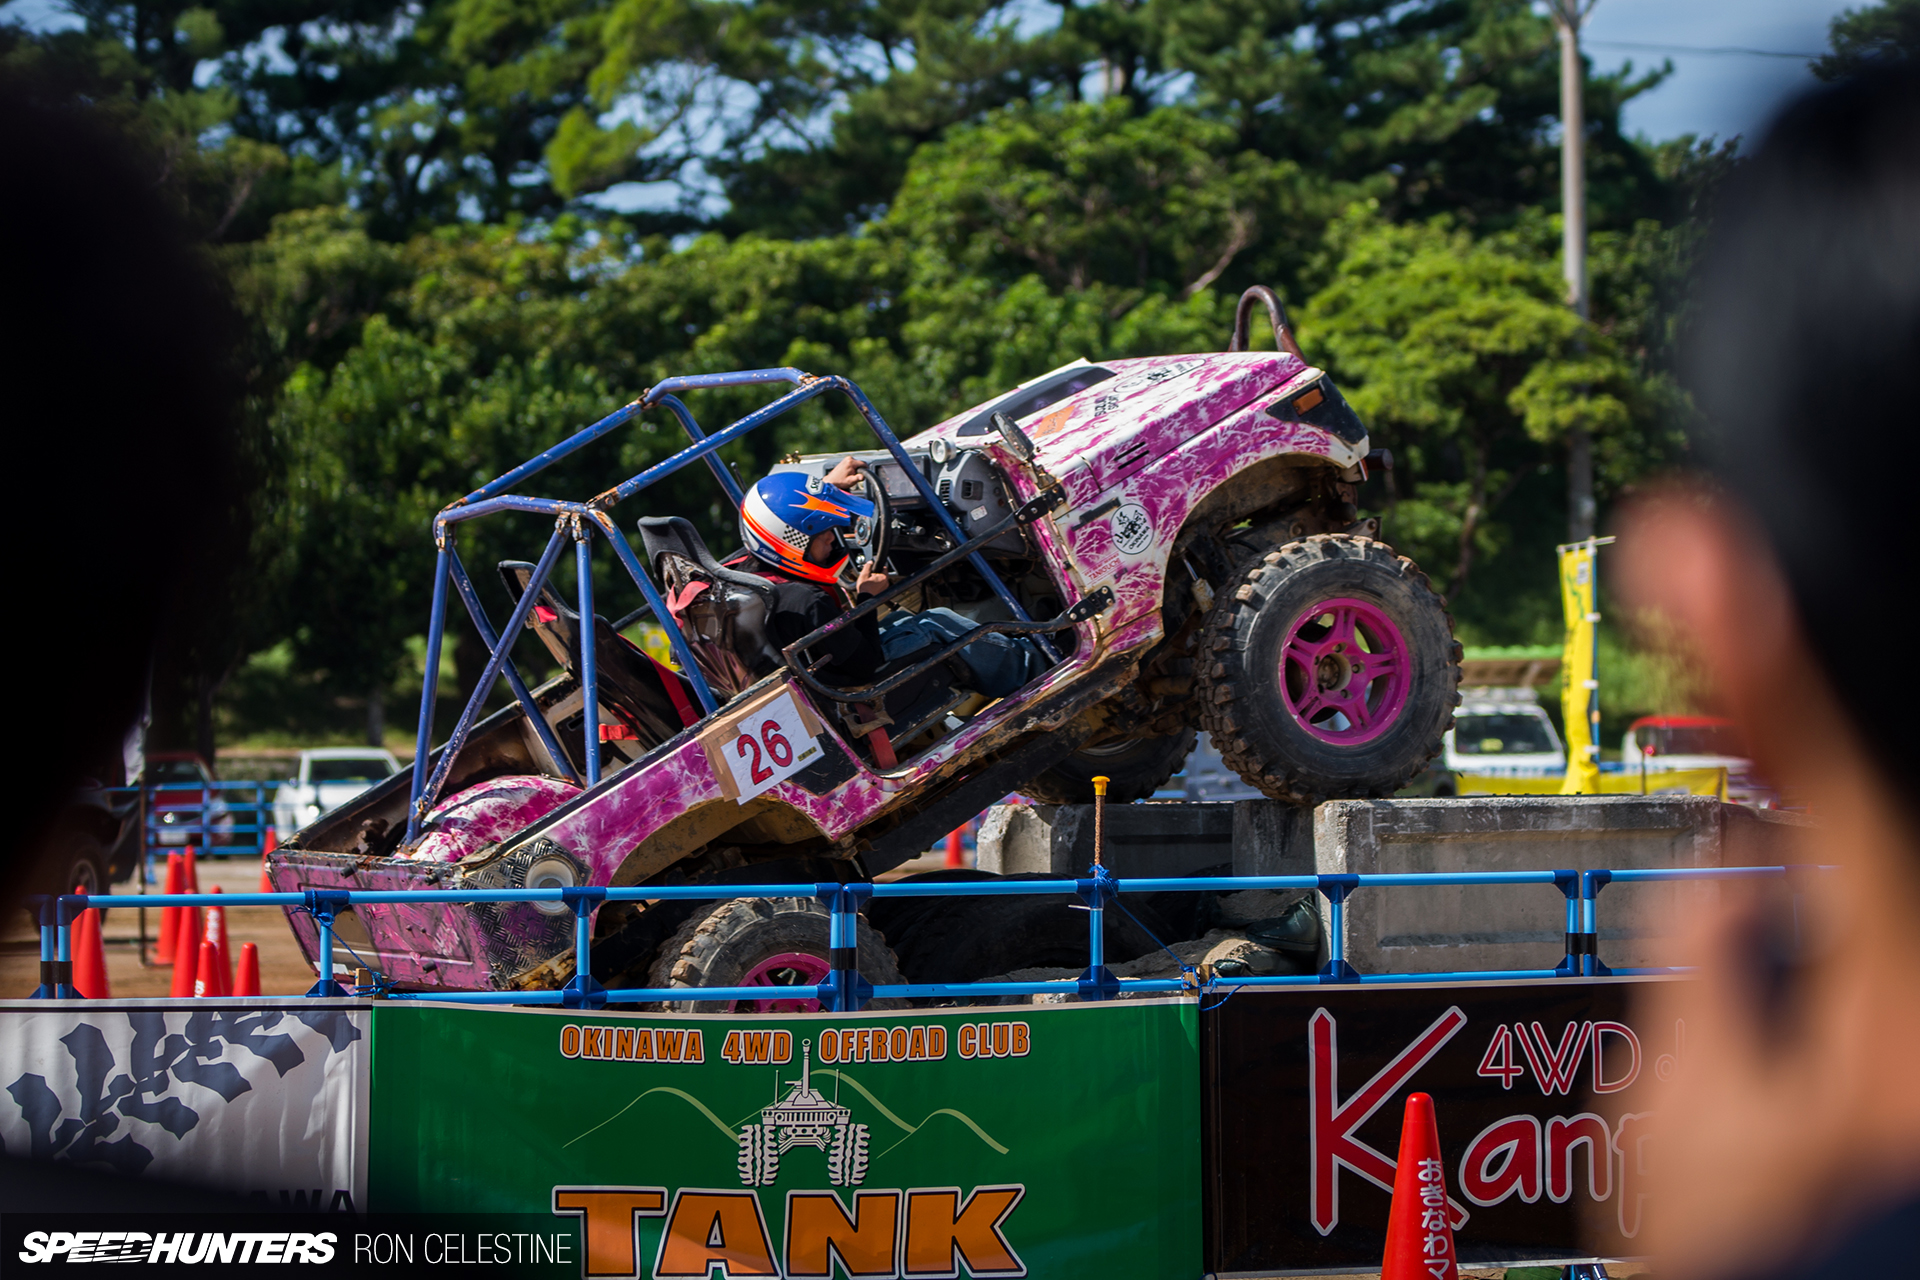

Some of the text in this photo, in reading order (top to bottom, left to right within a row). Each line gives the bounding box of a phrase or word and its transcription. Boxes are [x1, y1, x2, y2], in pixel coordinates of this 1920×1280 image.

[737, 719, 793, 785] 26
[560, 1022, 1031, 1065] OKINAWA 4WD OFFROAD CLUB
[1477, 1020, 1643, 1096] 4WD
[552, 1183, 1026, 1280] TANK
